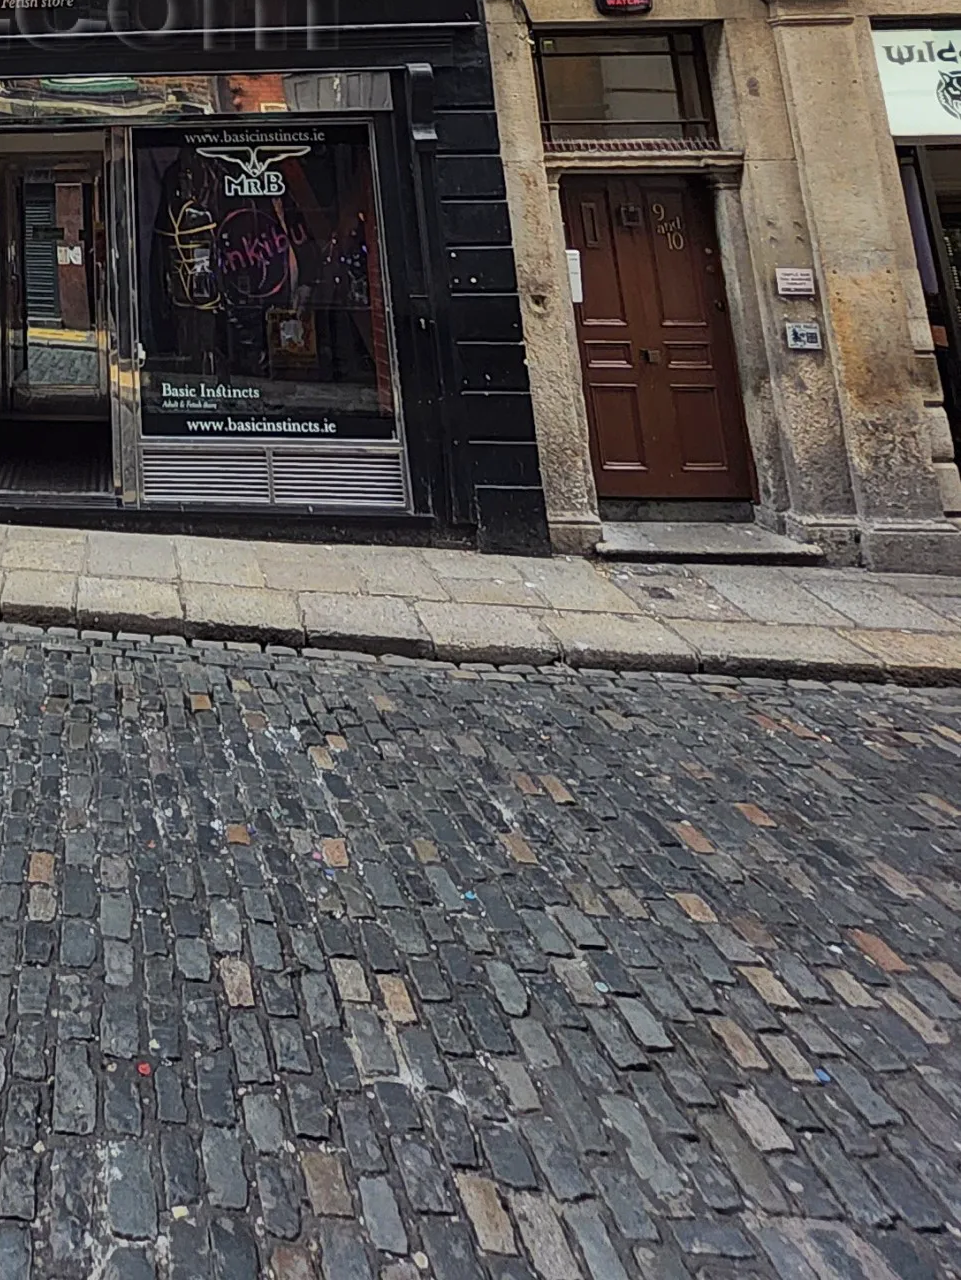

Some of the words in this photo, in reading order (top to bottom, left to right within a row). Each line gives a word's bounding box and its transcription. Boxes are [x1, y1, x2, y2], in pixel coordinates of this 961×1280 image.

[184, 128, 325, 144] www.basicinstincts.ie
[652, 203, 665, 221] 9
[657, 216, 681, 234] and
[667, 231, 684, 250] 10
[162, 383, 196, 398] Basic
[200, 383, 260, 399] Instincts
[186, 417, 337, 433] www.basicinstincts.ie
